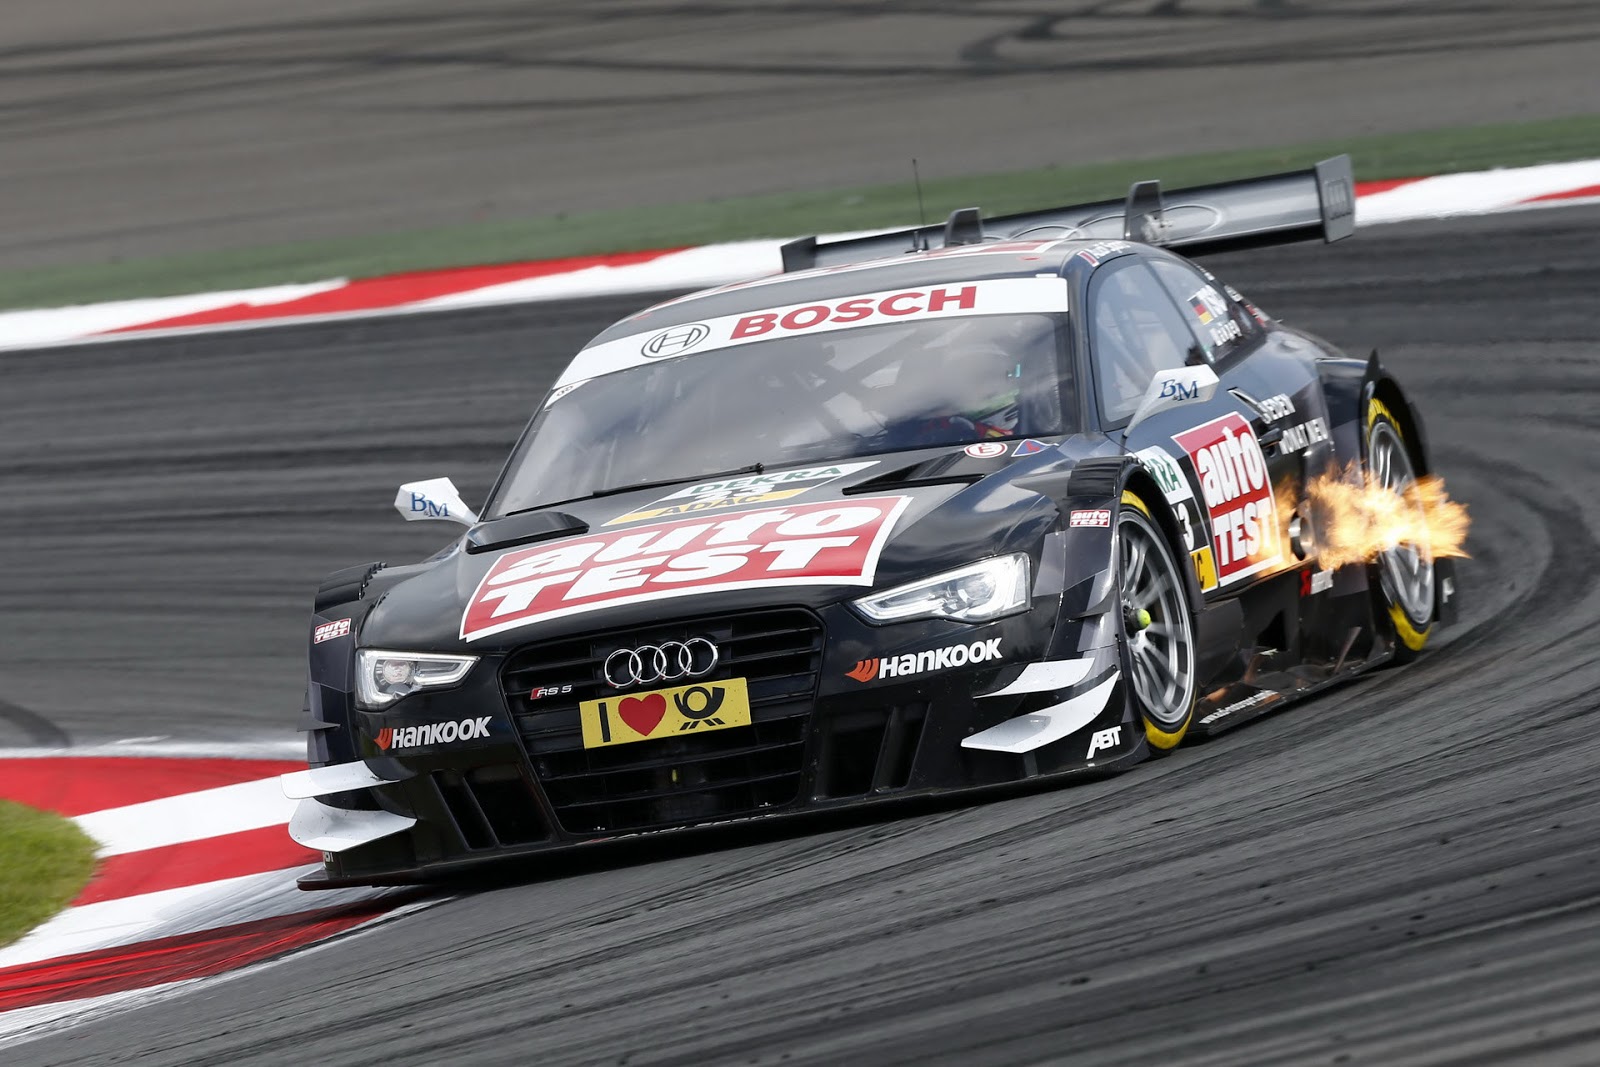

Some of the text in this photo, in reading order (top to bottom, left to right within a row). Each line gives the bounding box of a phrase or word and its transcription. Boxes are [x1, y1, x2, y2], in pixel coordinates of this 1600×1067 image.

[730, 286, 977, 340] BOSCH
[691, 467, 841, 492] DEKRA
[1196, 426, 1265, 508] auto
[655, 494, 765, 517] ADAC
[1071, 511, 1109, 519] auto
[487, 506, 884, 586] auto
[1212, 496, 1273, 567] TEST
[479, 536, 860, 618] TEST
[315, 621, 349, 636] auto
[315, 628, 348, 642] TEST
[536, 687, 559, 698] RS
[598, 702, 612, 743] I
[1086, 725, 1122, 760] ABT
